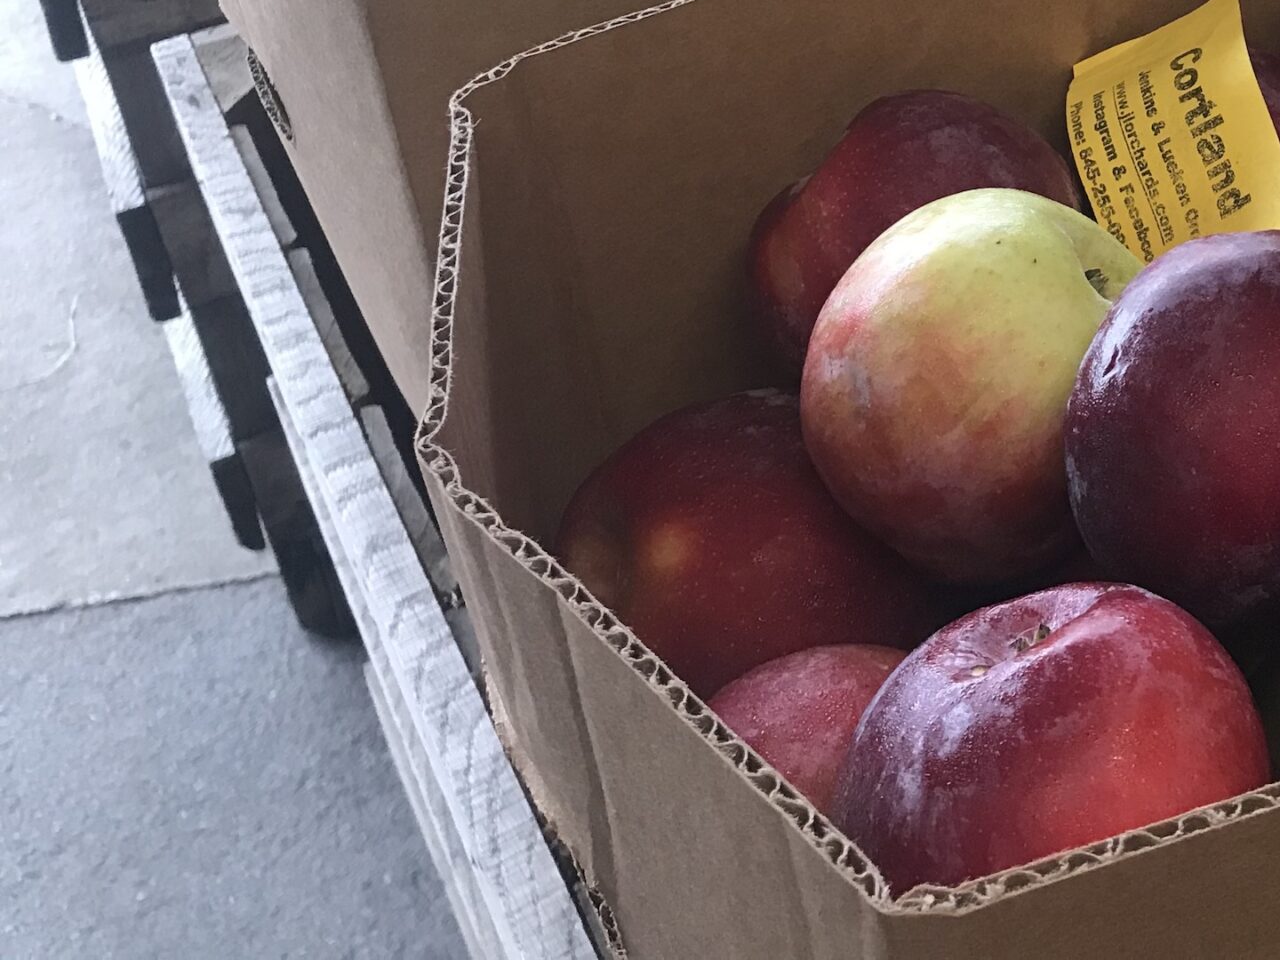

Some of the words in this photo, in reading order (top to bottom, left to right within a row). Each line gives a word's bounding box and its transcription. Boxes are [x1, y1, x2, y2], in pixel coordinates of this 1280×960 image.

[1070, 100, 1087, 147] Phone:
[1092, 90, 1118, 163] Instagram
[1111, 164, 1127, 182] &
[1138, 69, 1158, 118] Jenkins
[1151, 120, 1166, 137] &
[1169, 47, 1252, 220] Cortland
